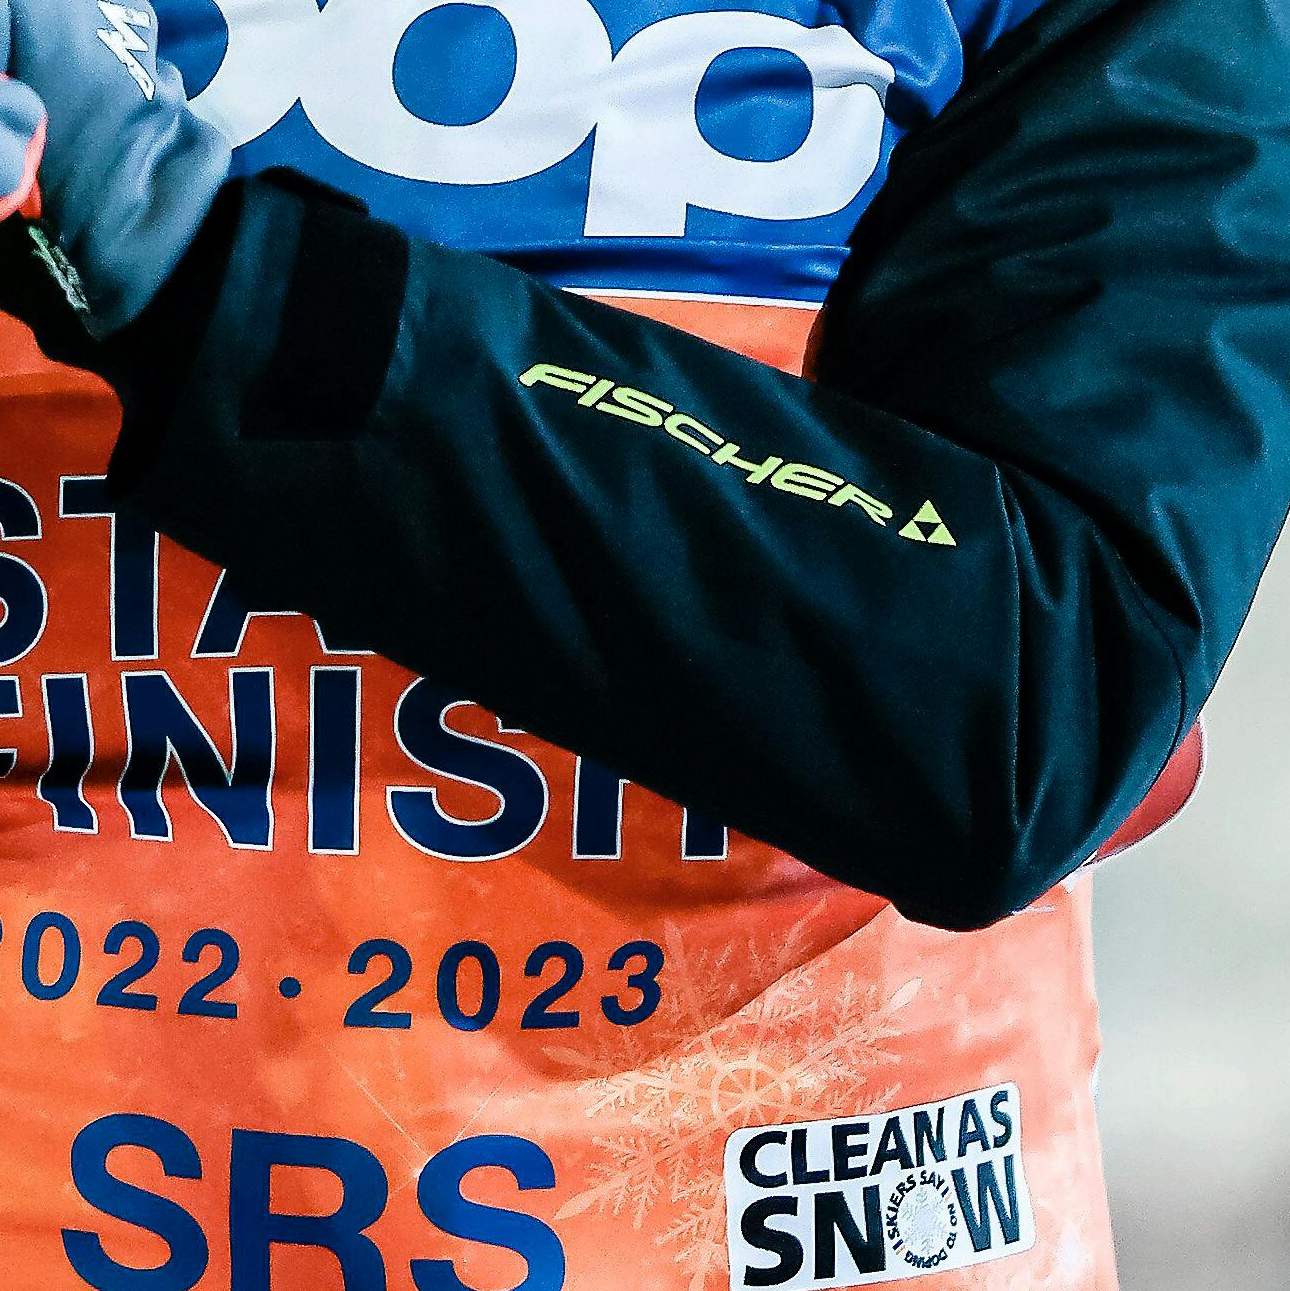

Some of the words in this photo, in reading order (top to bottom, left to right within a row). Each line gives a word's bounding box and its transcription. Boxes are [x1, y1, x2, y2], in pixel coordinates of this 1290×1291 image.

[517, 362, 894, 527] FISCHER
[342, 936, 666, 1032] 2023
[739, 1106, 948, 1188] CLEAN
[957, 1090, 1013, 1158] AS
[60, 1112, 567, 1291] SRS
[886, 1173, 917, 1240] SKIERS
